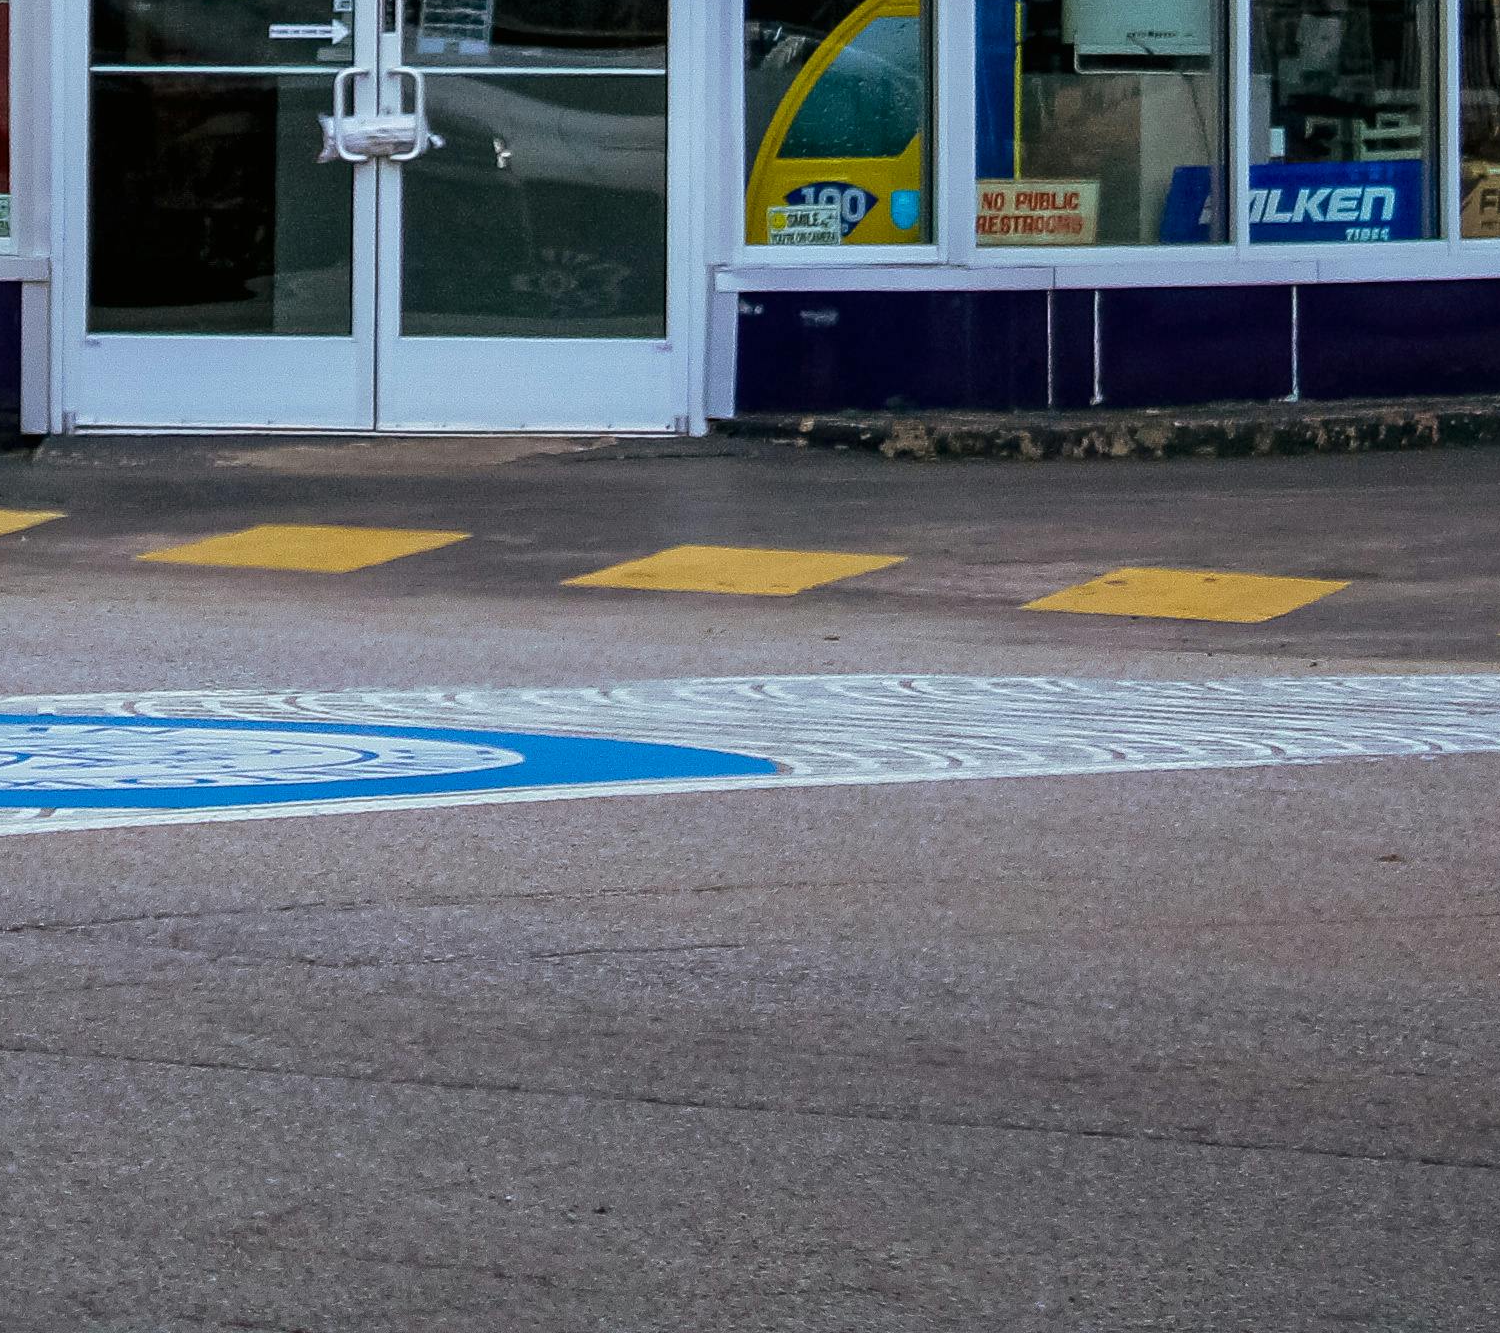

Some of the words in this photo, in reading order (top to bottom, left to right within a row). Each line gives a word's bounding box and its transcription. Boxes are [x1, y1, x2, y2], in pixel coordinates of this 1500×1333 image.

[982, 192, 1004, 211] NO
[1015, 191, 1080, 211] PUBLIC
[1198, 185, 1396, 223] ALKEN
[976, 214, 1084, 235] RESTROOMS
